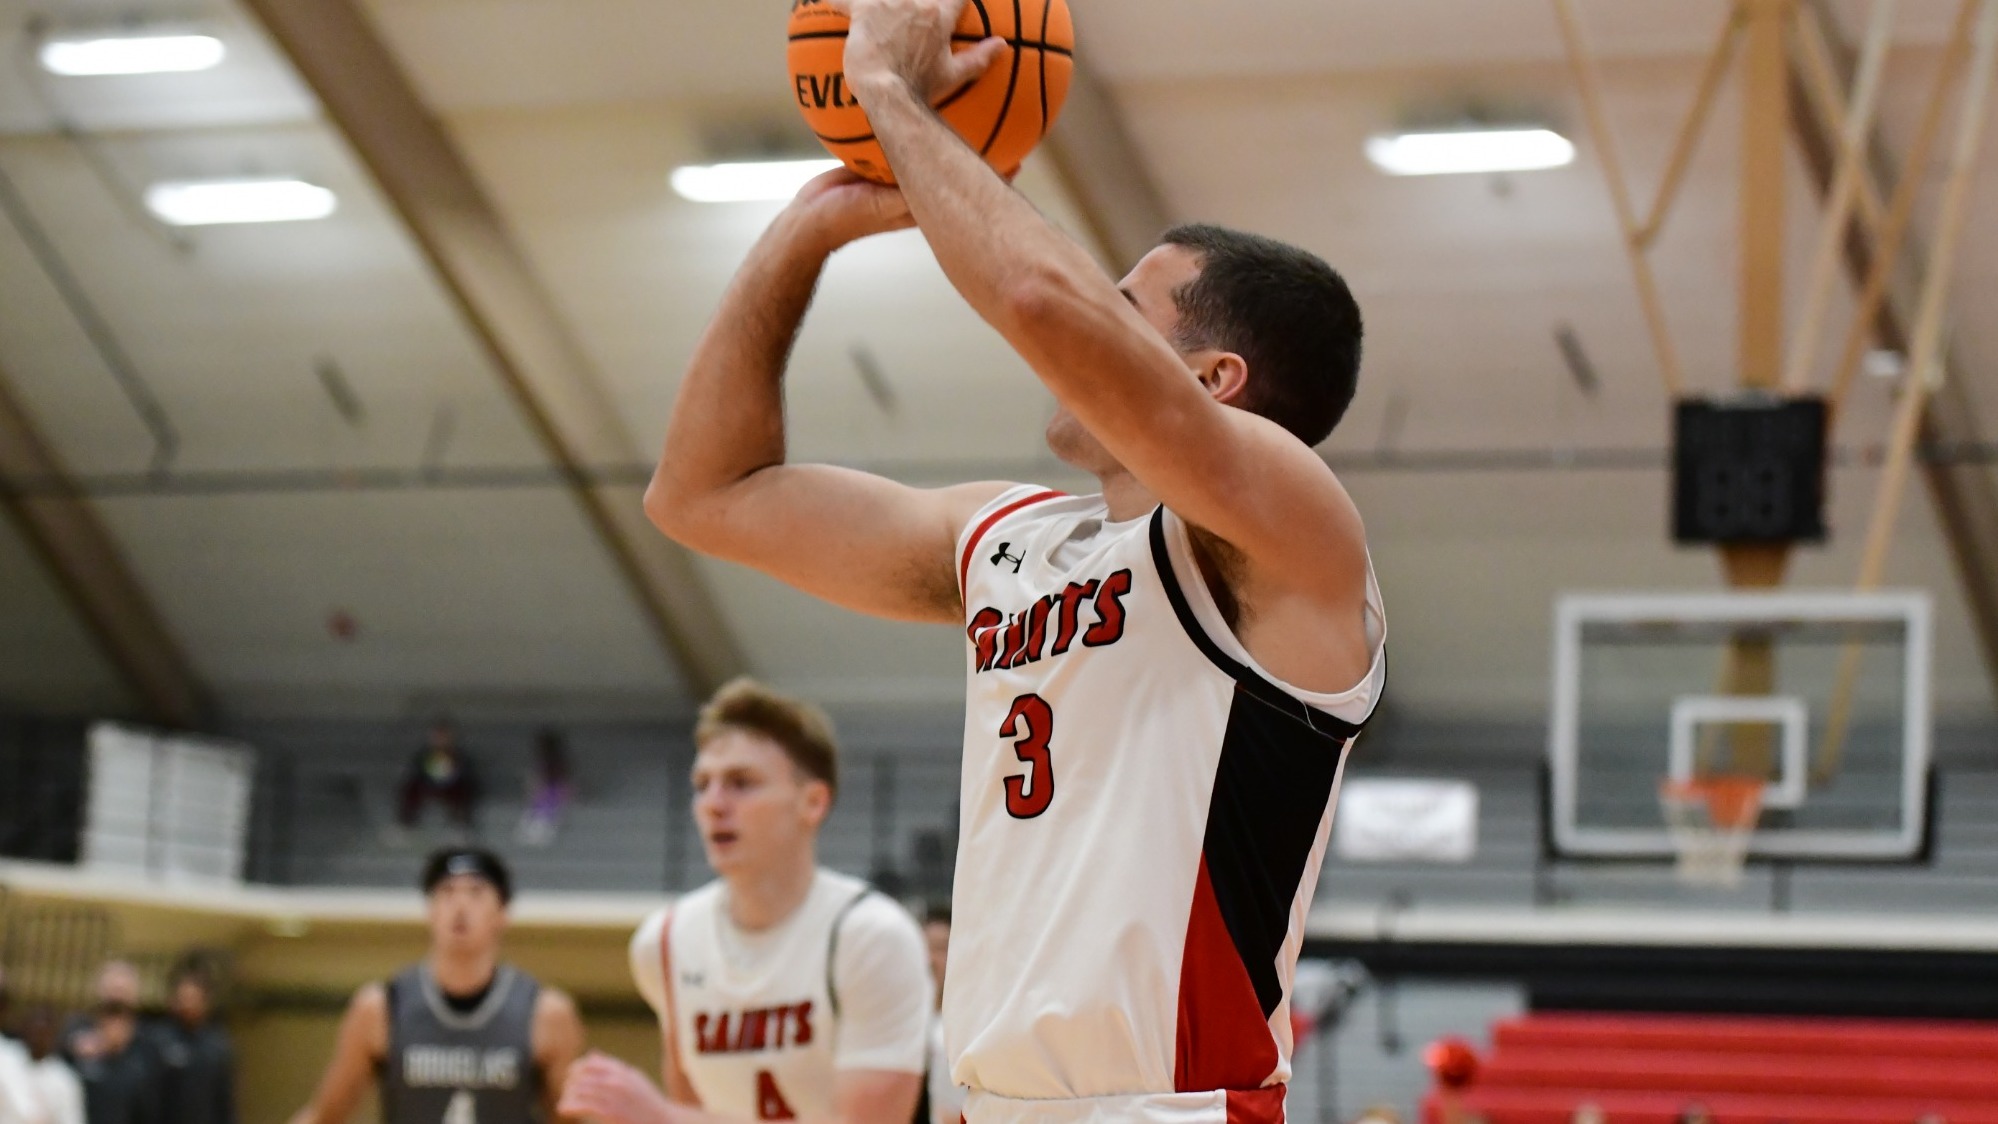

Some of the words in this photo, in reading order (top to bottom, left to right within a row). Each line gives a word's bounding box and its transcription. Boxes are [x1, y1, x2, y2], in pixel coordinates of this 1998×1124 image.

[999, 693, 1054, 818] 3
[695, 1000, 812, 1055] SAINTS
[756, 1070, 796, 1121] 4
